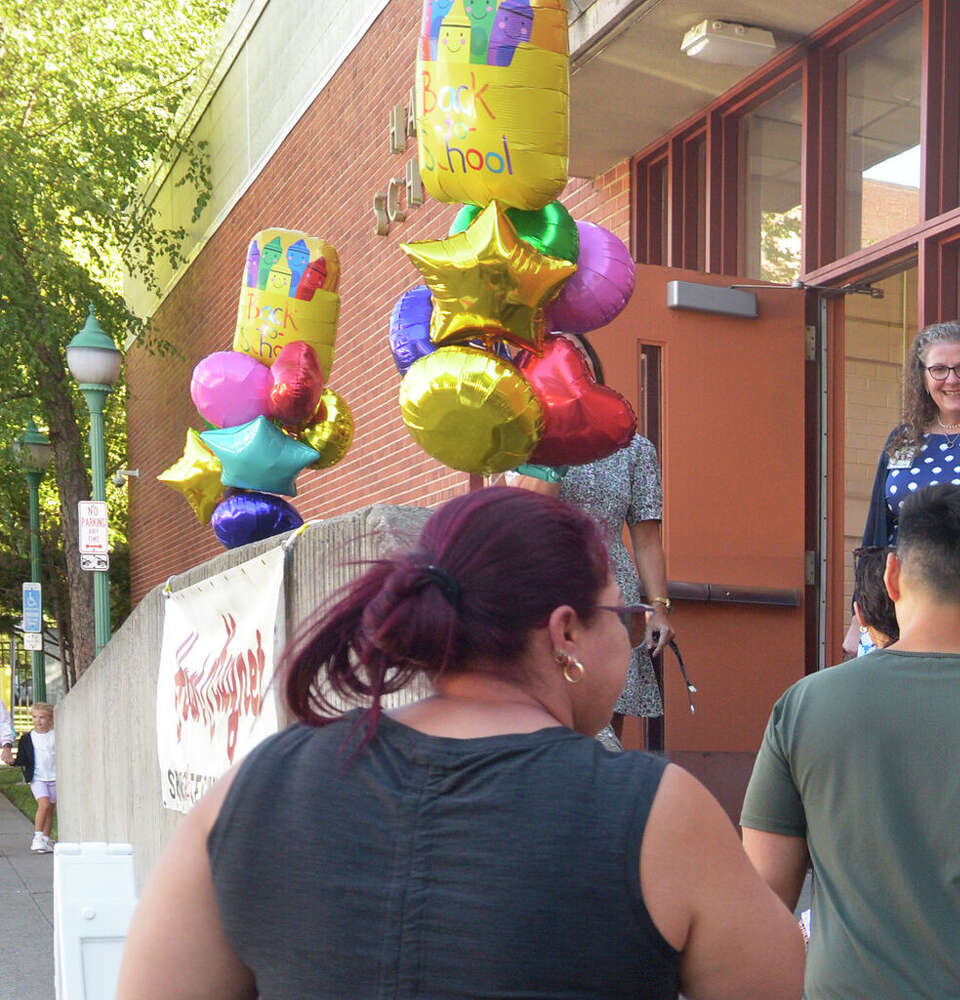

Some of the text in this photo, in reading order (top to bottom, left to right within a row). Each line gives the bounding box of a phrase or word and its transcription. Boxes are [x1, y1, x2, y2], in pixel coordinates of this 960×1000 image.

[421, 71, 497, 120] Back
[247, 292, 299, 332] Back
[81, 517, 106, 528] PARKING
[88, 505, 99, 517] NO
